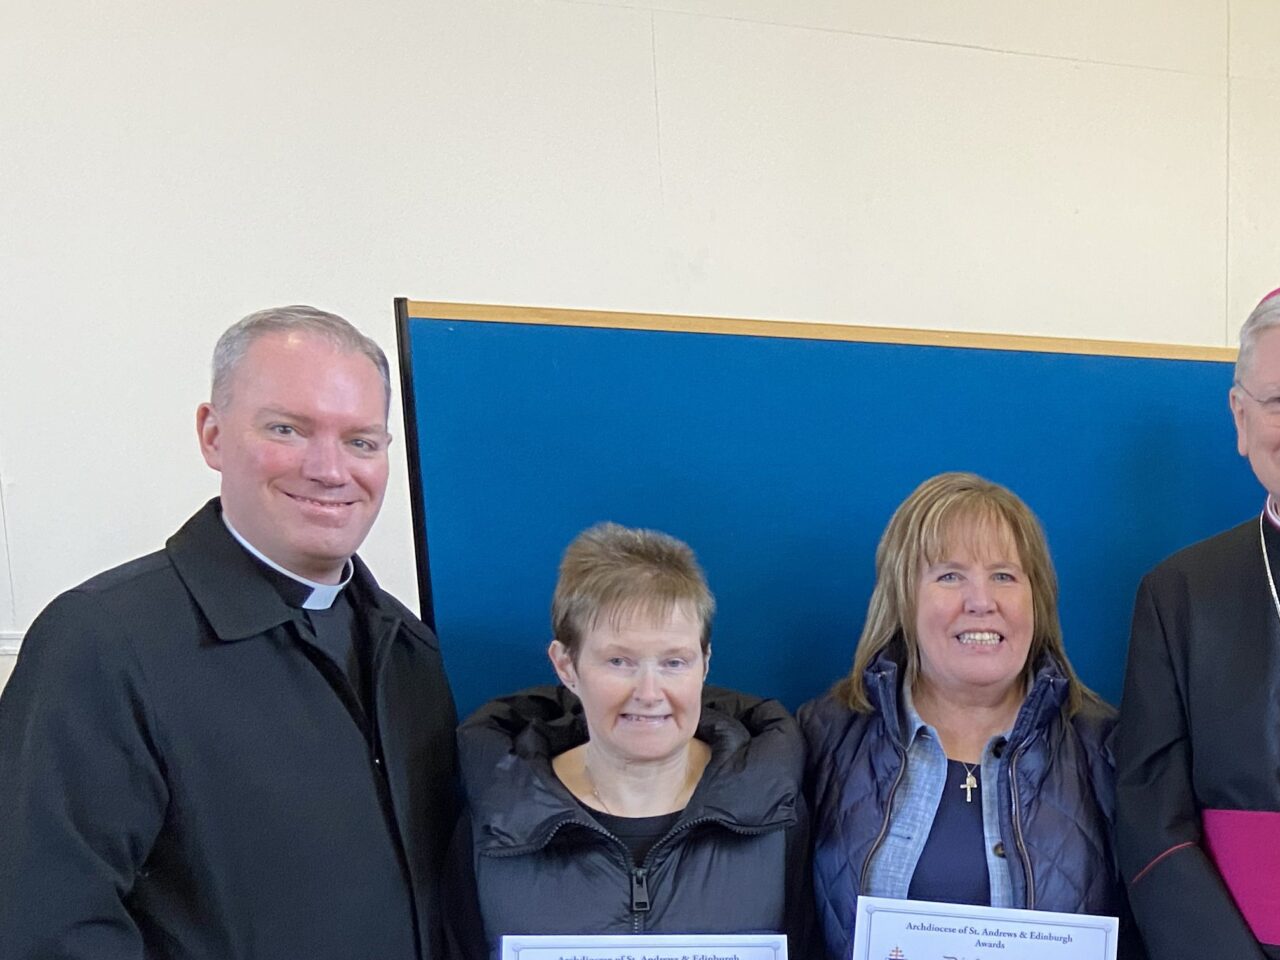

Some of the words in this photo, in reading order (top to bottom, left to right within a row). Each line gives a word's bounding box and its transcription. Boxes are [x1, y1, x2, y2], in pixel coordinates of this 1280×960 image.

[906, 922, 956, 934] Archdiocese
[958, 926, 968, 934] of
[969, 926, 980, 936] St.
[982, 928, 1017, 939] Andrews
[1019, 931, 1027, 939] &
[1030, 931, 1072, 943] Edinburgh
[975, 940, 1005, 949] Awards
